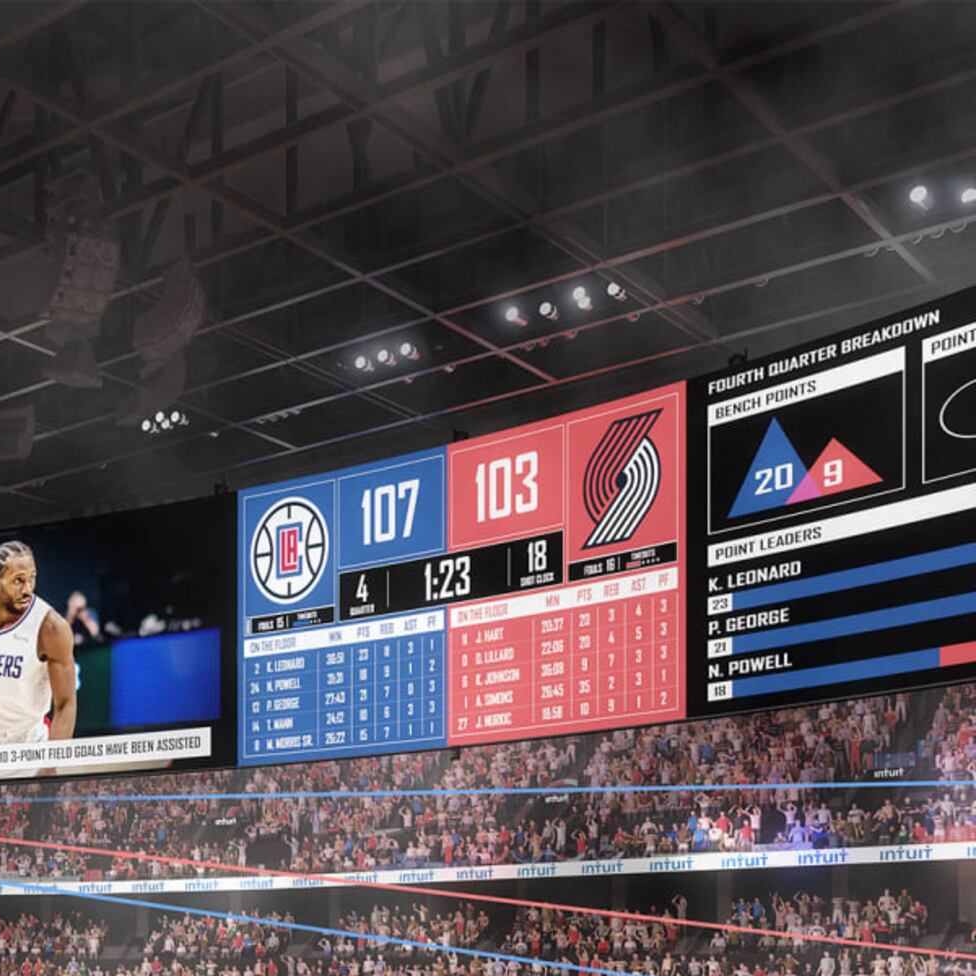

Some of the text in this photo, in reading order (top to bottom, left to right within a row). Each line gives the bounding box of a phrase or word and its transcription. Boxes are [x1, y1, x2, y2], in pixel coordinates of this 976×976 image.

[709, 310, 940, 395] FOURTH QUARTER BREAKDOWN
[716, 381, 816, 419] BENCH POINTS
[754, 463, 793, 496] 20
[824, 460, 843, 488] 9
[475, 451, 538, 523] 103
[361, 478, 420, 545] 107
[715, 527, 822, 560] POINT LEADERS
[528, 540, 547, 572] 18
[425, 555, 470, 602] 1:23
[709, 560, 801, 592] K. LEONARD
[356, 574, 368, 602] 4
[713, 598, 728, 609] 23
[709, 607, 790, 634] P. GEORGE
[714, 641, 727, 653] 21
[709, 653, 792, 678] N. POWELL
[714, 685, 726, 696] 18
[11, 749, 45, 763] 3-POINT
[48, 747, 72, 761] FIELD
[74, 744, 103, 760] GOALS
[106, 742, 128, 757] HAVE
[131, 741, 155, 755] BEEN
[157, 736, 201, 753] ASSISTED
[722, 853, 768, 867] intuit
[798, 850, 848, 864] intuit
[880, 846, 933, 860] intuit
[518, 863, 557, 876] intuit
[582, 860, 624, 874] intuit
[650, 857, 694, 871] intuit
[400, 871, 434, 882] intuit
[456, 868, 492, 879] intuit
[79, 883, 112, 893] intuit
[131, 882, 164, 892] intuit
[185, 880, 218, 891] intuit
[240, 878, 273, 889] intuit
